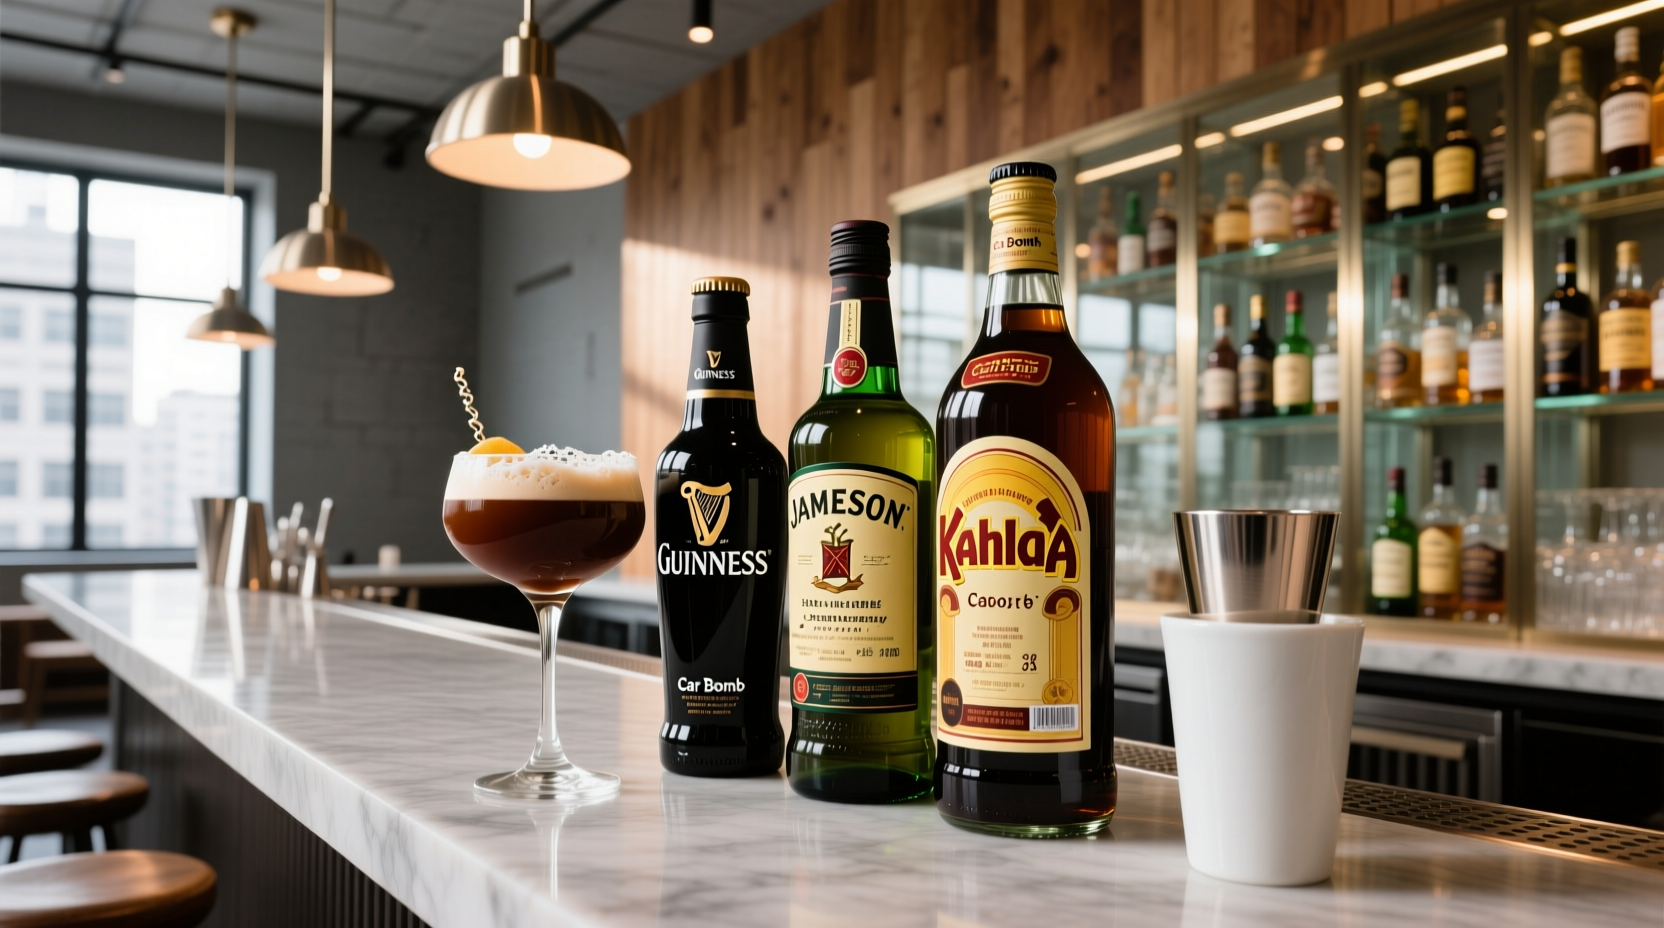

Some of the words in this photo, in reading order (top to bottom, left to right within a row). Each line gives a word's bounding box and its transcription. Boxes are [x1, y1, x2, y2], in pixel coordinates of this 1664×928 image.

[693, 367, 736, 380] GUINNESS
[790, 488, 907, 530] JAMESON
[657, 542, 769, 576] GUINNESS
[677, 676, 701, 692] Car
[703, 677, 746, 693] Bomb
